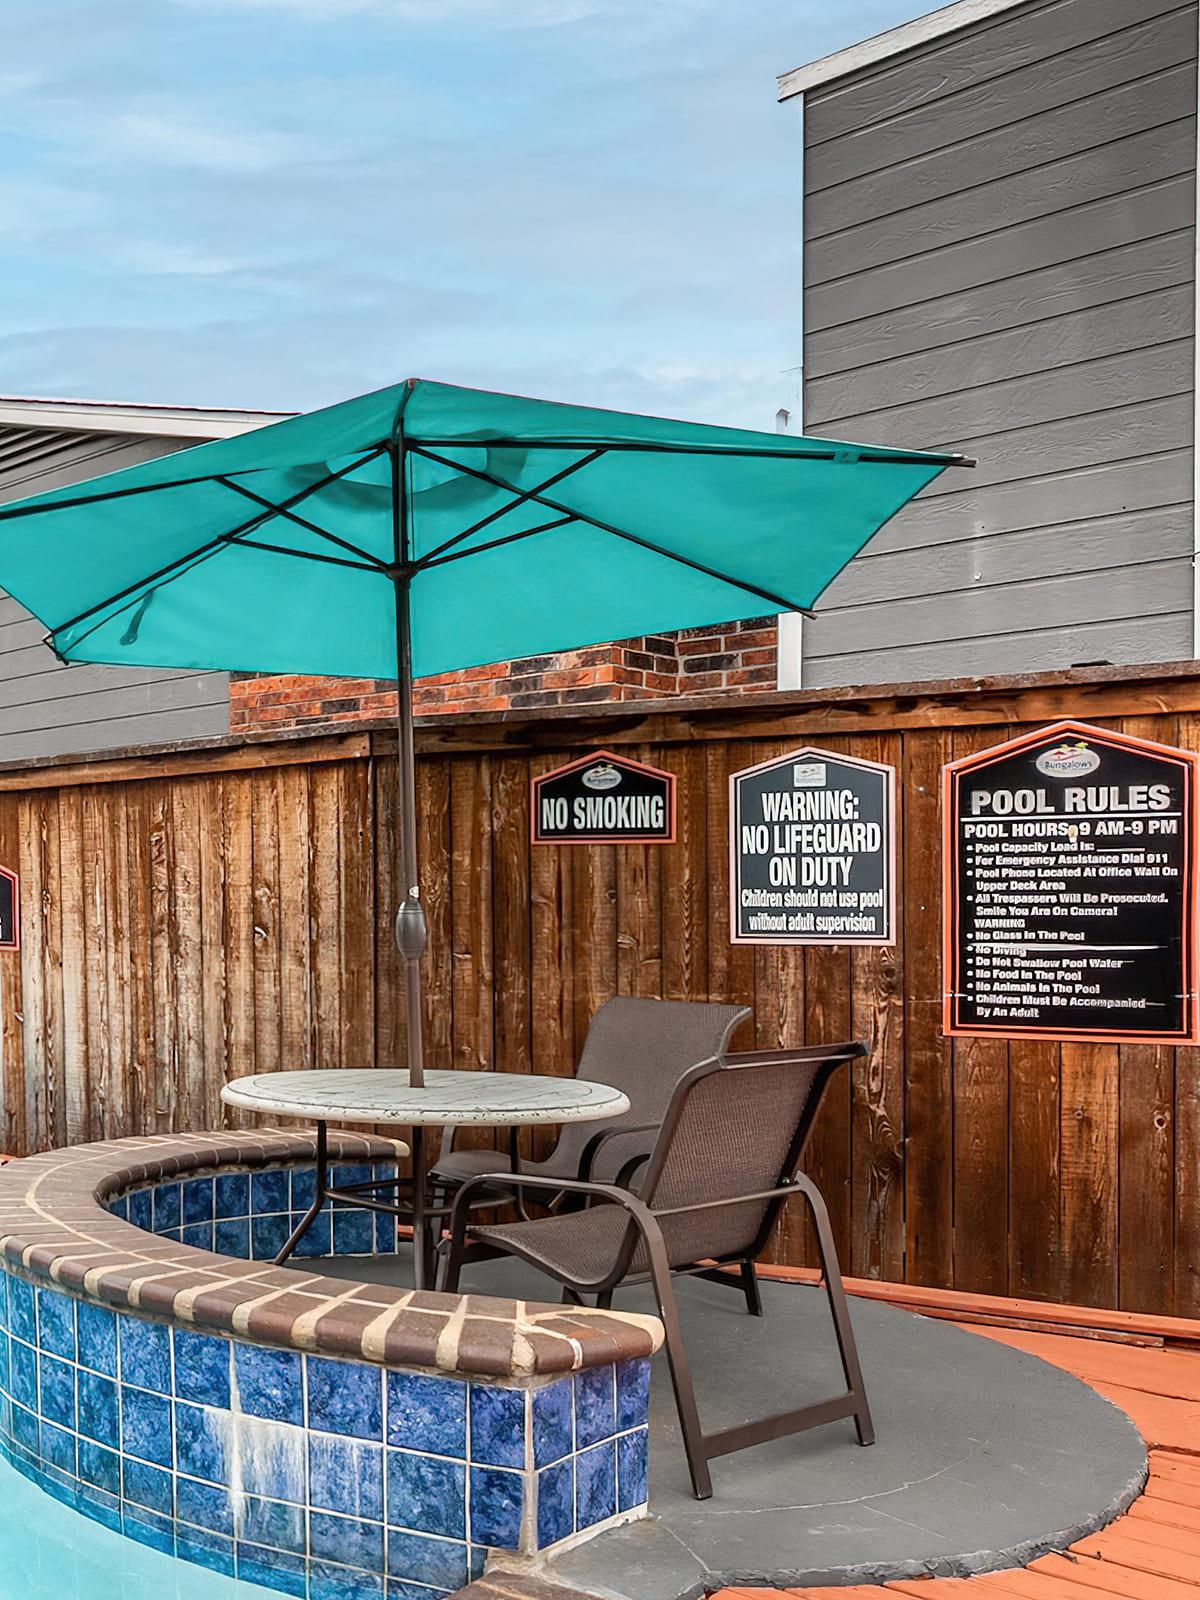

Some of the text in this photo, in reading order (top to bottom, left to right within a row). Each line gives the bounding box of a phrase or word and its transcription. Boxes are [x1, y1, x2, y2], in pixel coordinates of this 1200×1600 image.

[1045, 761, 1092, 770] Bungalows
[762, 790, 859, 822] WARNING:
[971, 785, 1170, 815] POOL RULES
[542, 796, 663, 829] NO SMOKING
[965, 824, 1009, 838] POOL
[1080, 822, 1090, 836] 9
[1149, 820, 1177, 834] PM
[743, 823, 881, 854] NO LIFEGUARD
[976, 844, 999, 852] Pool
[1002, 843, 1048, 854] Capacity
[1051, 842, 1078, 851] Load
[975, 854, 1168, 867] For Emergency Assistance Dial 911
[769, 857, 853, 886] ON DUTY
[976, 867, 1178, 878] Pool Phone Located At Office Wall On
[976, 881, 1066, 892] Upper Deck Area
[742, 889, 883, 911] Children should not use pool
[976, 894, 990, 903] All
[992, 894, 1057, 904] Trespassers
[1059, 894, 1080, 903] Will
[1083, 894, 1098, 903] Be
[976, 907, 1118, 916] Smile You Are On Camera!
[749, 912, 875, 934] without adult supervision
[974, 919, 1025, 928] WARNING
[976, 931, 1085, 940] No Glass In The Pool
[993, 944, 1026, 957] Diving
[976, 957, 1123, 968] Do Not Swallow Pool Water
[976, 970, 1081, 980] No Food In The Pool
[976, 982, 1100, 994] No Animals In The Pool
[976, 995, 1146, 1009] Children Must Be Accompanied
[977, 1008, 1039, 1017] By An Adult
